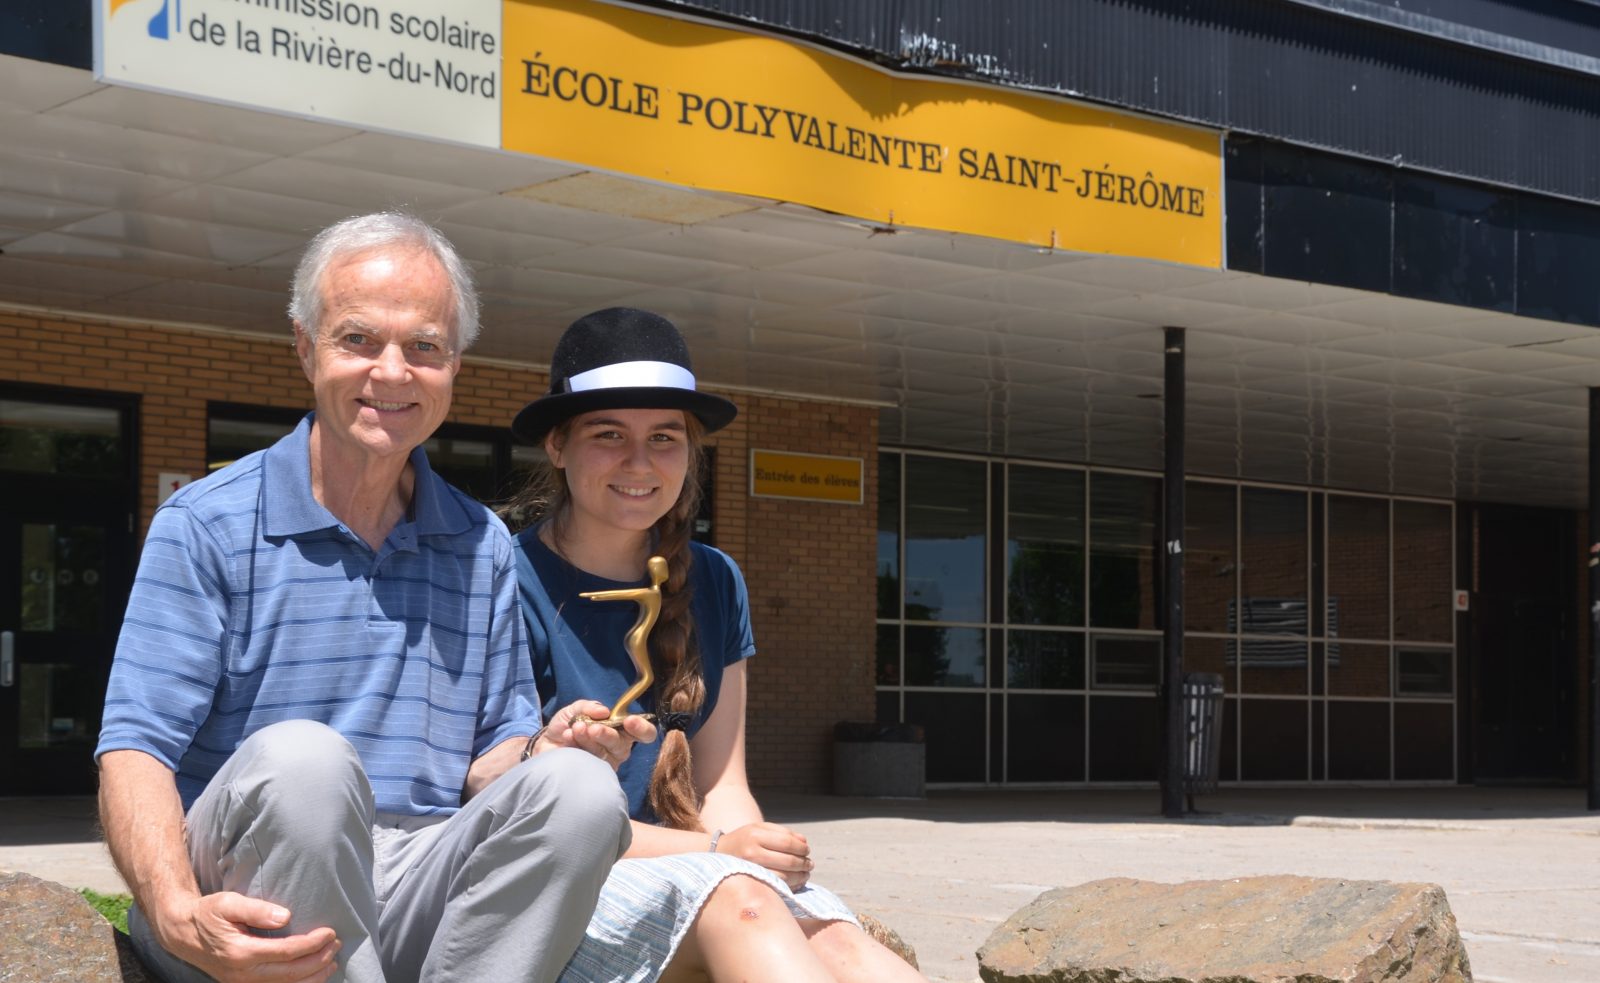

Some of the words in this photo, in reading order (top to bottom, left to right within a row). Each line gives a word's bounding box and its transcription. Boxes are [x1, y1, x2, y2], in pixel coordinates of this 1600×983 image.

[188, 12, 227, 47] de
[236, 20, 261, 54] la
[271, 27, 497, 99] Rivière-du-Nord
[389, 11, 496, 55] scolaire
[521, 51, 659, 119] ÉCOLE
[677, 91, 943, 173] POLYVALENTE
[958, 147, 1205, 217] SAINT-JÉRÔME
[755, 468, 796, 482] Entrée
[800, 472, 820, 485] des
[824, 474, 860, 488] élèves
